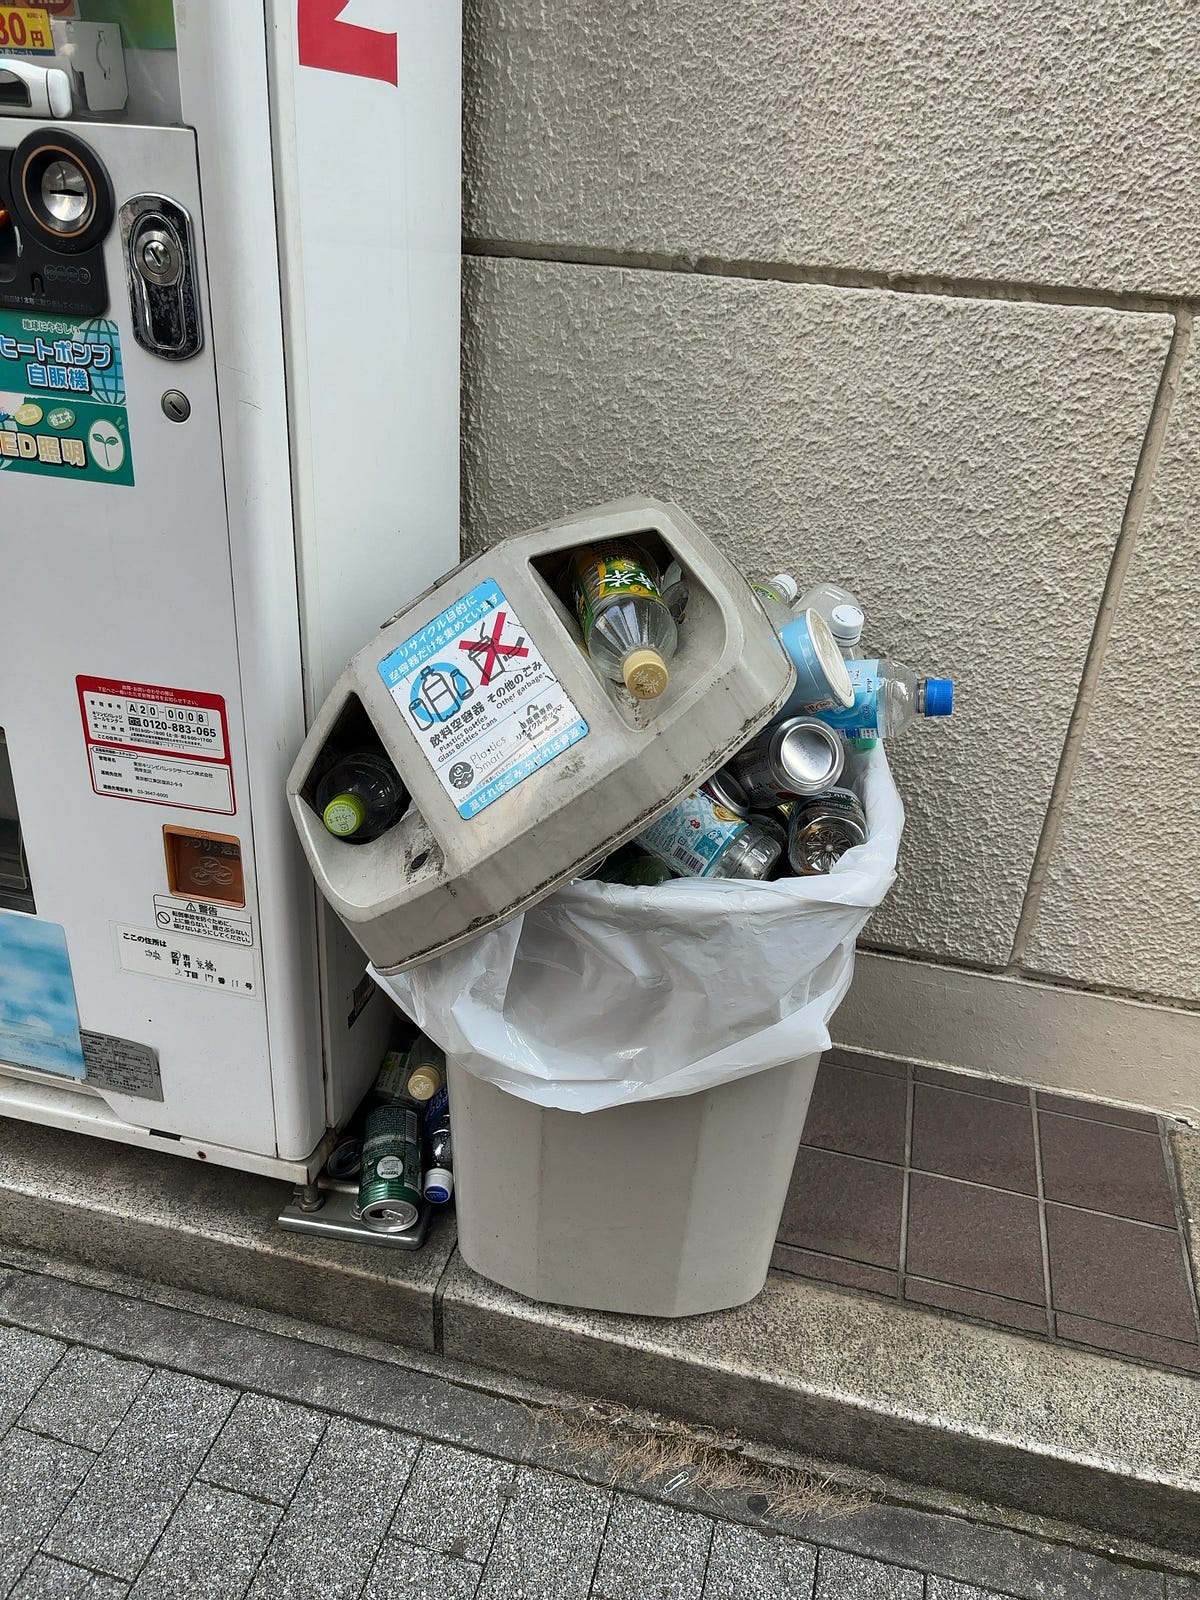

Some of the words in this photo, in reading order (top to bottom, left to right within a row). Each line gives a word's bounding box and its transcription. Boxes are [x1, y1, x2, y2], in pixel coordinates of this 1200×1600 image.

[22, 318, 80, 334] 地球にやさしい
[0, 335, 111, 367] ヒートポンプ
[27, 363, 90, 391] 自販機
[20, 407, 39, 421] エコ
[49, 410, 73, 427] 省エネ
[0, 431, 86, 467] ED照明
[388, 593, 498, 683] 空容器だけを集めています
[400, 595, 478, 657] リサイクル目的に
[429, 701, 486, 749] 飲料空容器
[486, 661, 543, 704] その他のごみ
[496, 697, 517, 710] Other
[517, 676, 543, 697] garbage
[143, 718, 217, 738] 0120-883-065
[439, 733, 465, 754] Plastics
[469, 736, 507, 767] Plastics
[438, 749, 456, 763] Glass
[475, 751, 505, 775] Smart
[199, 904, 218, 916] 警告
[122, 932, 167, 947] ここの住所は
